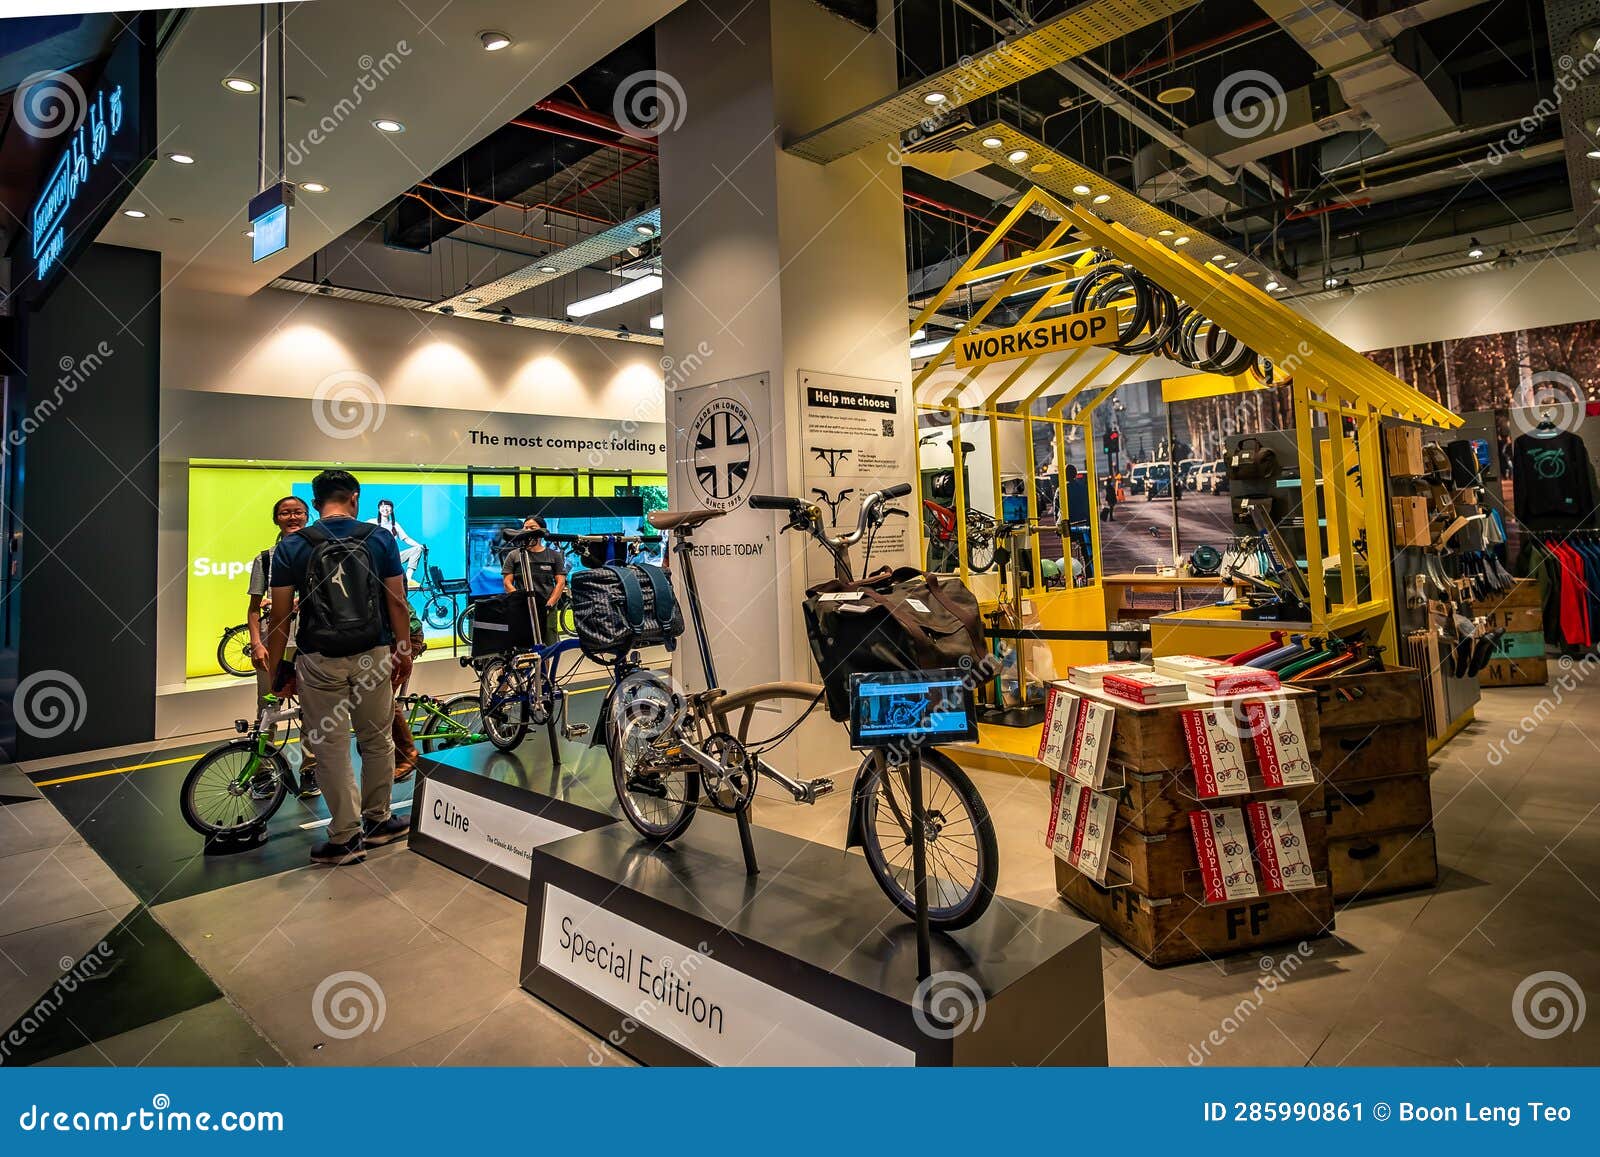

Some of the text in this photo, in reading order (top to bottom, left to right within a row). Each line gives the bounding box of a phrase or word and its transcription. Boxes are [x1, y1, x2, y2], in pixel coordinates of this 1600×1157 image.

[963, 316, 1106, 361] WORKSHOP
[695, 401, 748, 430] MADE IN LONDON
[815, 390, 890, 409] Help me choose
[469, 430, 499, 446] The
[503, 434, 543, 448] most
[546, 438, 608, 453] compact
[611, 438, 656, 456] folding
[711, 544, 731, 556] RIDE
[733, 543, 764, 556] TODAY
[1194, 716, 1216, 794] BROMPTON
[1258, 709, 1280, 784] BROMPTON
[433, 799, 470, 832] C Line
[1201, 817, 1224, 899] BROMPTON
[1259, 809, 1281, 889] BROMPTON
[559, 917, 724, 1035] Special Edition
